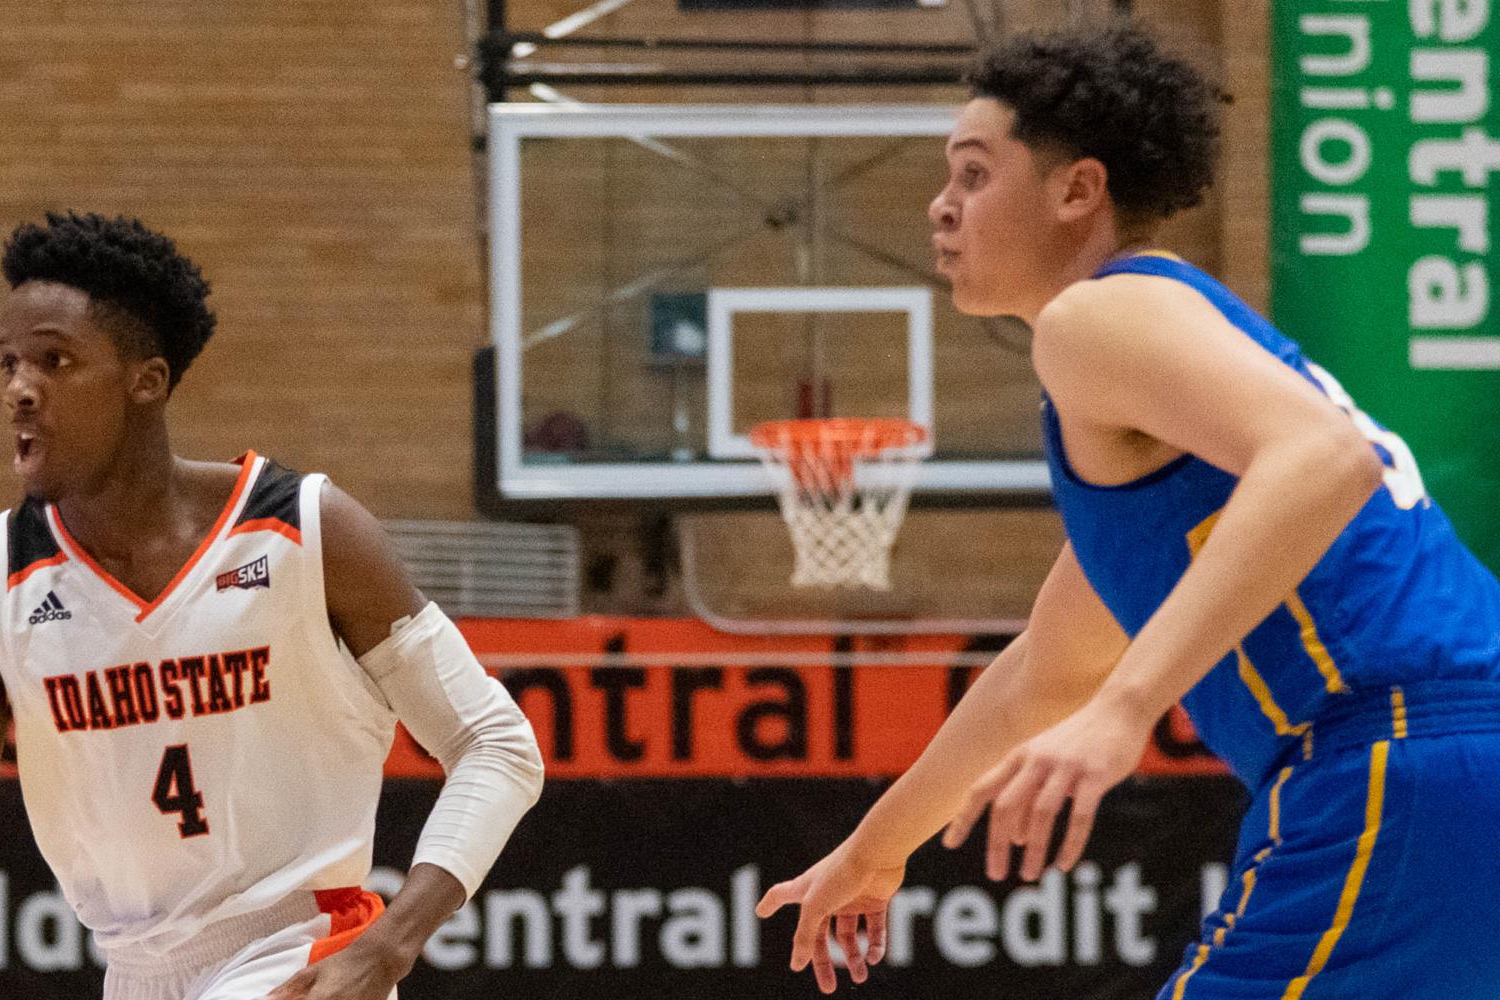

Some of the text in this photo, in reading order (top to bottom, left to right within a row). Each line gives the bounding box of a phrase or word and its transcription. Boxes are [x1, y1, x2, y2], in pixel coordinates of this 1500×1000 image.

[1299, 0, 1395, 257] nion
[28, 608, 72, 625] adidas
[43, 645, 271, 733] IDAHO STATE
[150, 744, 210, 839] 4
[368, 864, 760, 970] entral
[827, 863, 1159, 968] redit
